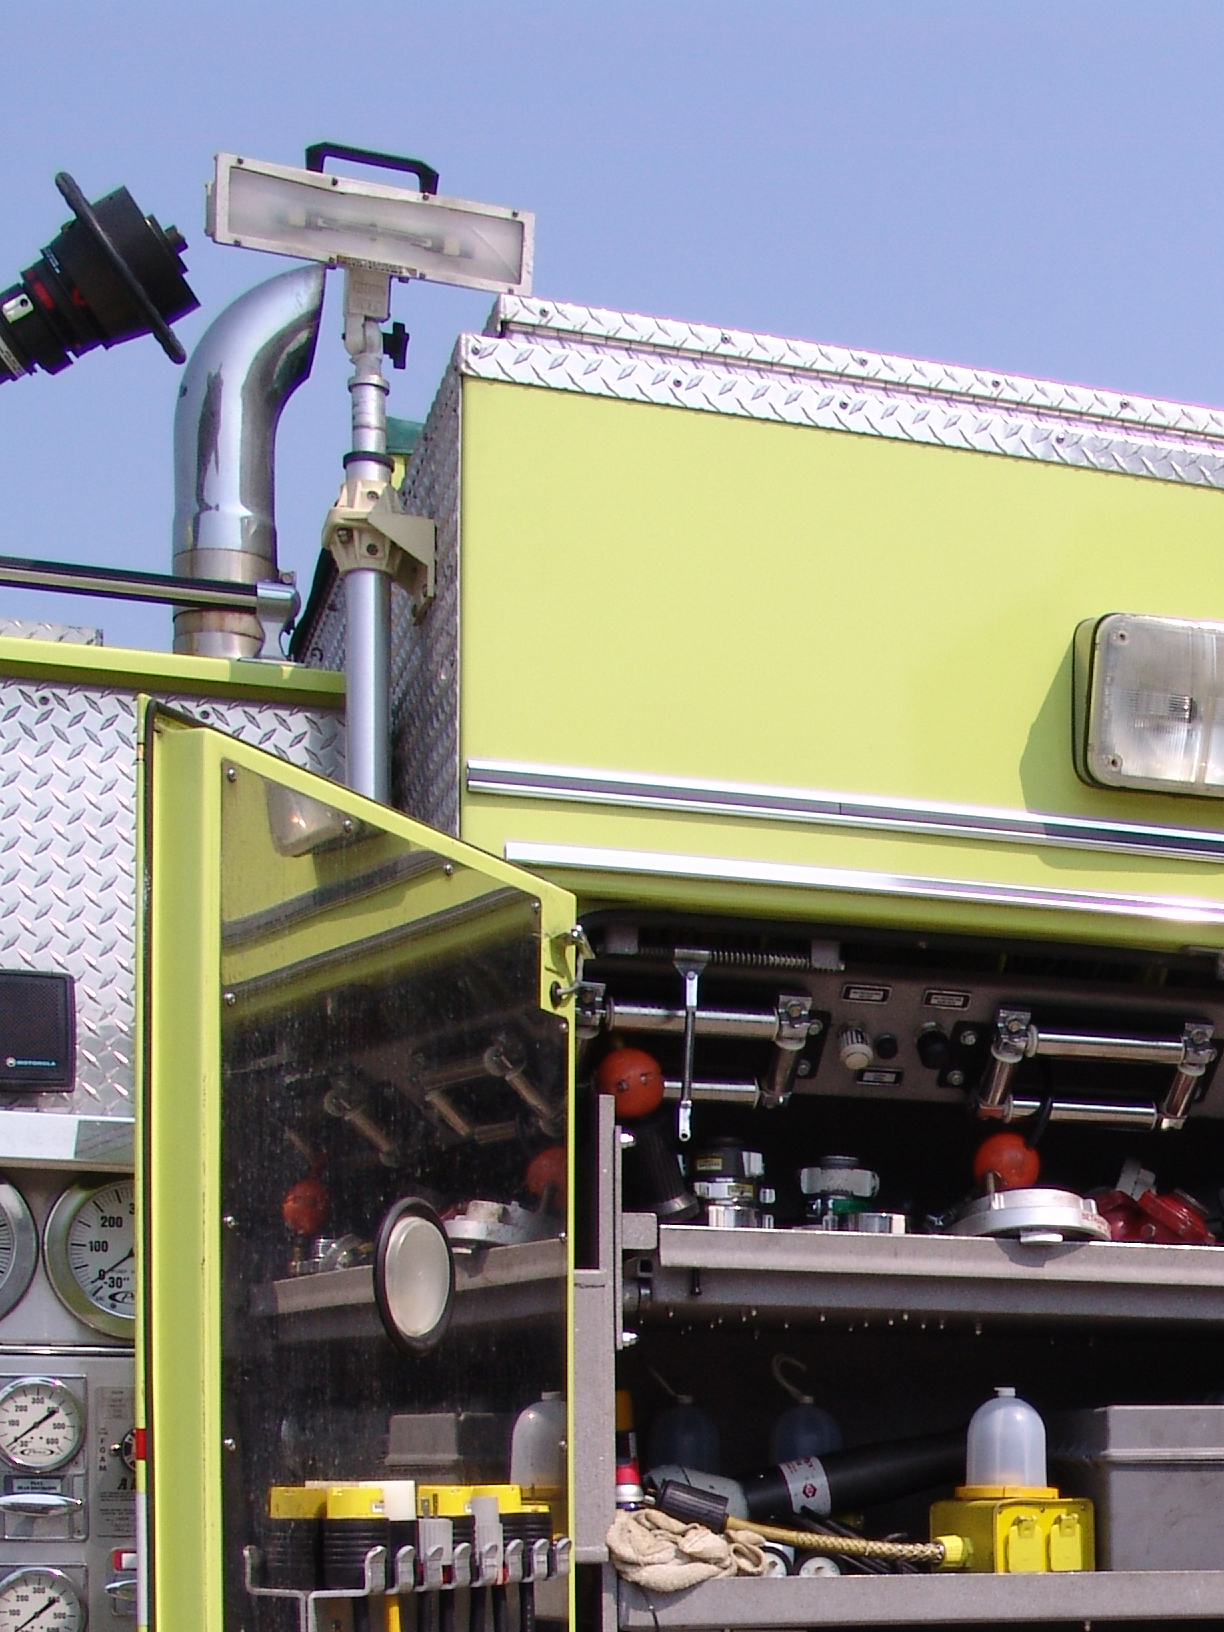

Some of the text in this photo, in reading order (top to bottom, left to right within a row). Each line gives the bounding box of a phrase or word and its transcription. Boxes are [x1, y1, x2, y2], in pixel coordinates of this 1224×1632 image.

[100, 1216, 123, 1228] 200
[89, 1240, 109, 1252] 100
[31, 1397, 45, 1405] 300
[14, 1405, 28, 1413] 200
[8, 1419, 20, 1427] 100
[53, 1422, 66, 1430] 500
[15, 1594, 29, 1602] 200
[8, 1608, 21, 1616] 100
[53, 1612, 66, 1620] 500
